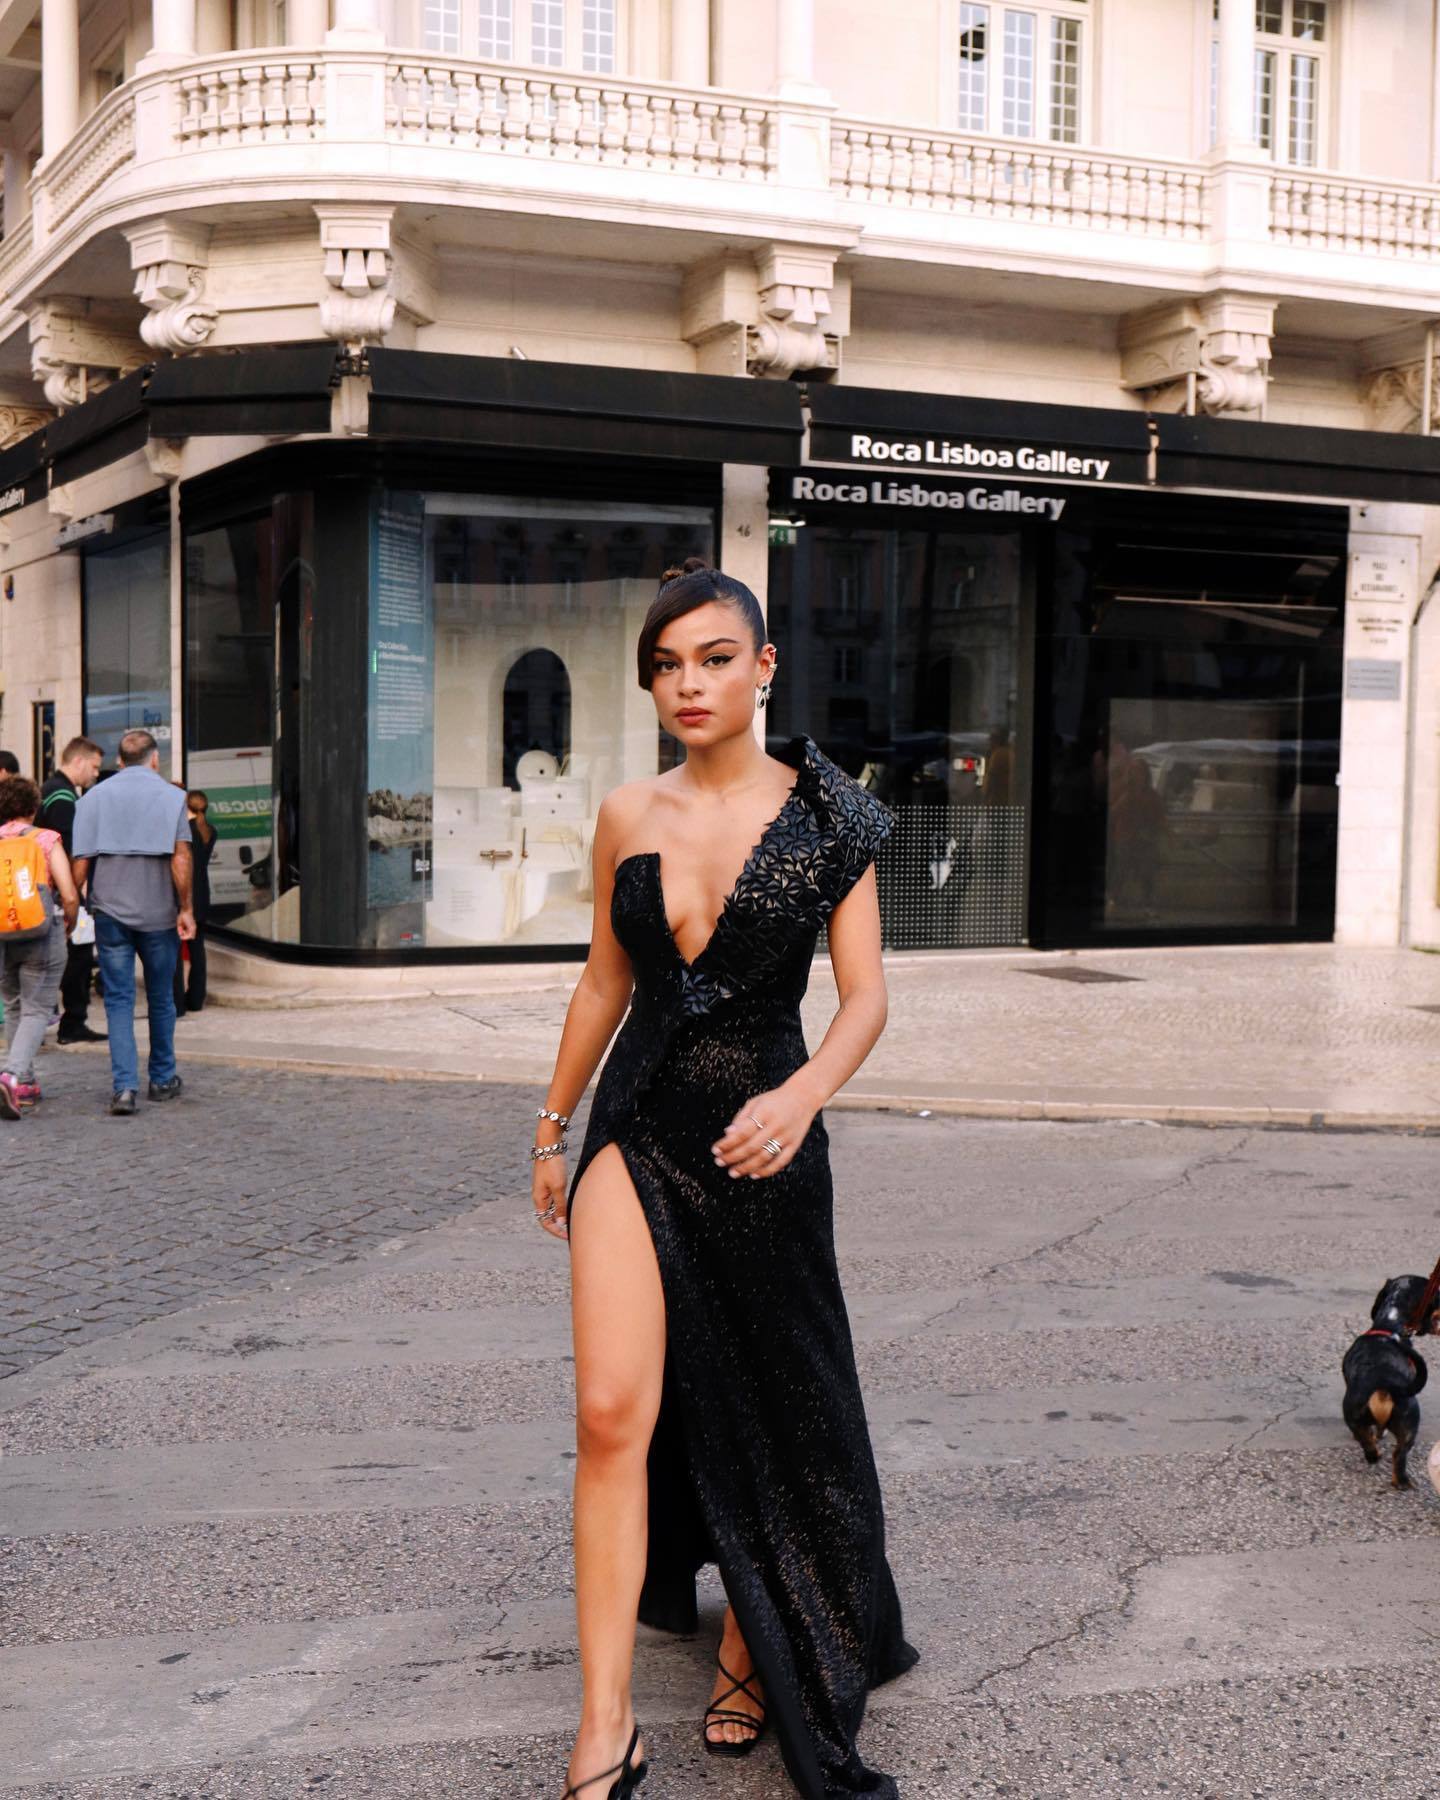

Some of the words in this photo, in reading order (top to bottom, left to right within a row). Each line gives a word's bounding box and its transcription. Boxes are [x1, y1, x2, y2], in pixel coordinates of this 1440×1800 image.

[851, 434, 922, 462] Roca
[926, 440, 1014, 469] Lisboa
[1016, 447, 1110, 480] Gallery
[792, 476, 868, 503] Roca
[871, 481, 965, 509] Lisboa
[967, 487, 1066, 521] Gallery
[736, 524, 751, 537] 46
